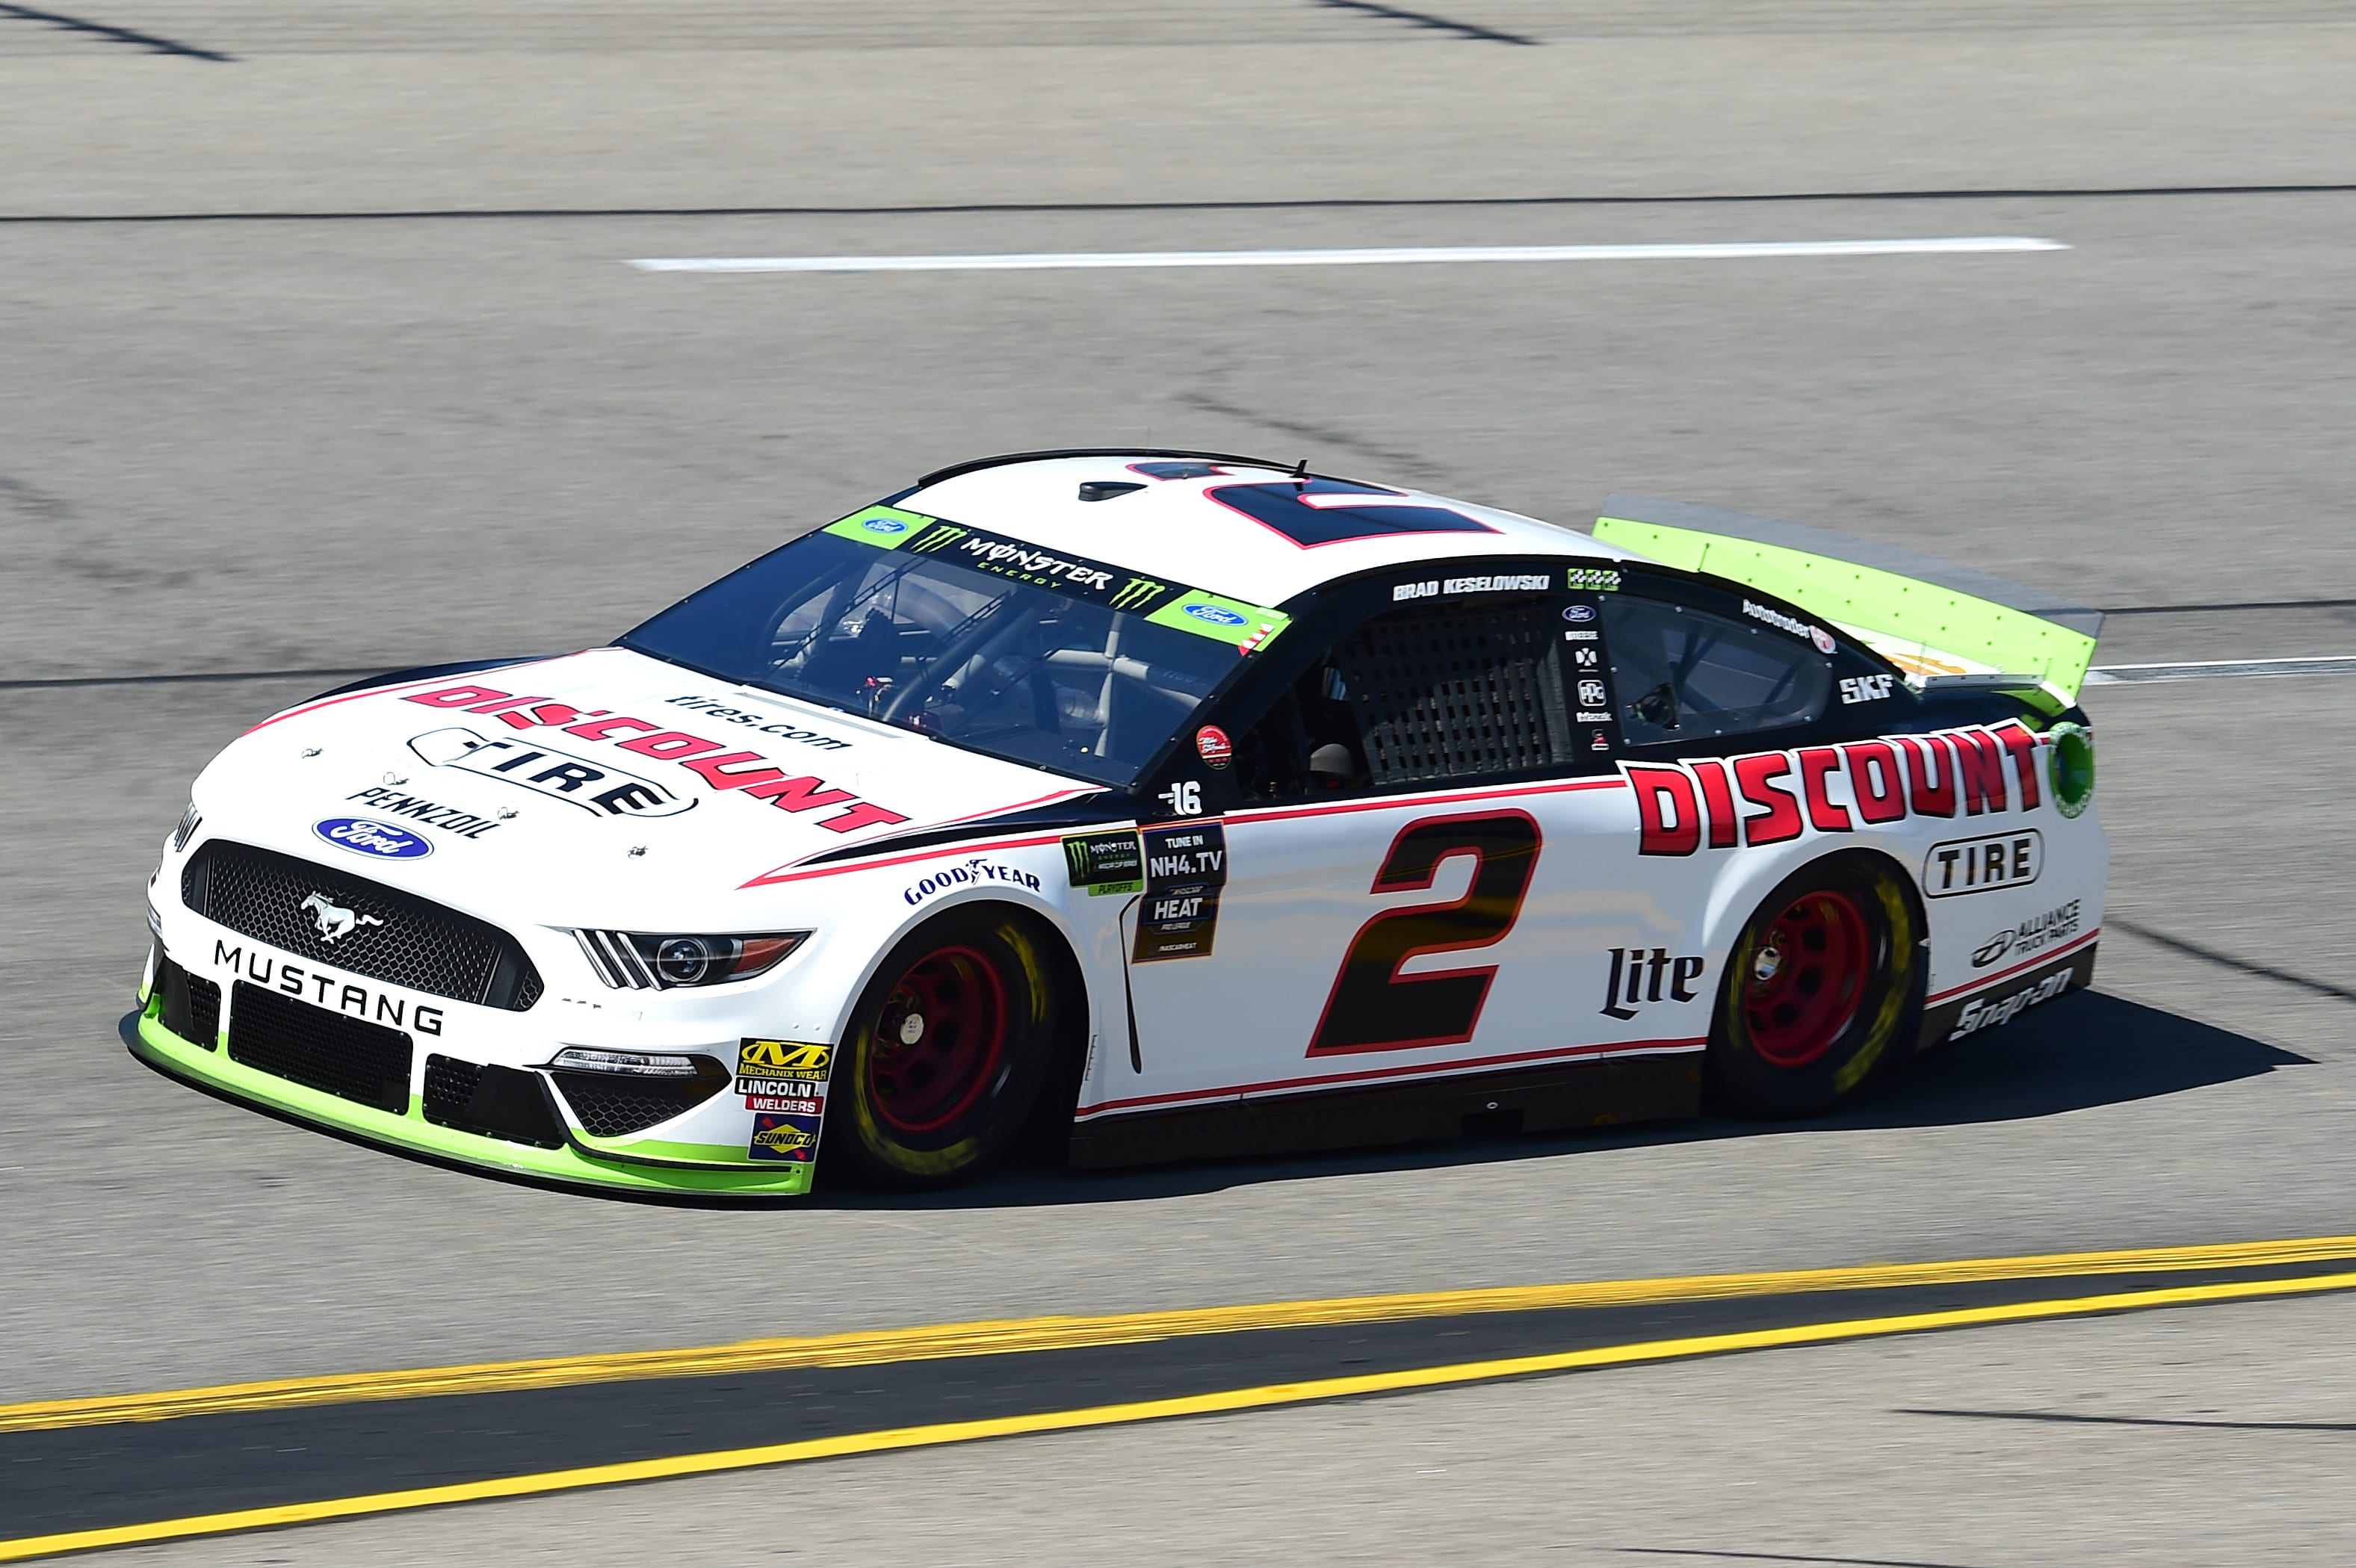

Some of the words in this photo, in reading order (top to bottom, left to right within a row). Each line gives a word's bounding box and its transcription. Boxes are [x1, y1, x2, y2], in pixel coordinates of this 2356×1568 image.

[865, 518, 907, 533] Ford
[977, 562, 1062, 589] ENERGY
[1392, 580, 1439, 601] BRAD
[1442, 574, 1550, 595] KESELOWSKI
[1189, 604, 1243, 625] Ford
[1580, 682, 1604, 703] PPG
[1838, 674, 1893, 704] SKF
[664, 694, 859, 752] tires.com
[400, 685, 912, 834] DISCOUNT
[1620, 721, 2041, 858] DISCOUNT
[345, 787, 501, 840] PENNZOIL
[330, 820, 405, 856] Ford
[1165, 837, 1191, 849] TUNE
[1193, 834, 1204, 847] IN
[1150, 850, 1222, 878] NH4.TV
[1937, 837, 2032, 889] TIRE
[1154, 897, 1203, 920] HEAT
[2018, 897, 2082, 937] ALLIANCE
[1305, 808, 1543, 1059] 2
[214, 939, 443, 1036] MUSTANG
[1598, 947, 1704, 1020] Lite
[1948, 967, 2074, 1041] Snap-on
[739, 1063, 794, 1079] MECHANIX
[796, 1068, 827, 1080] WEAR
[738, 1079, 811, 1097] LINCOLN
[753, 1097, 816, 1113] WELDERS
[755, 1131, 814, 1147] SUNOCO
